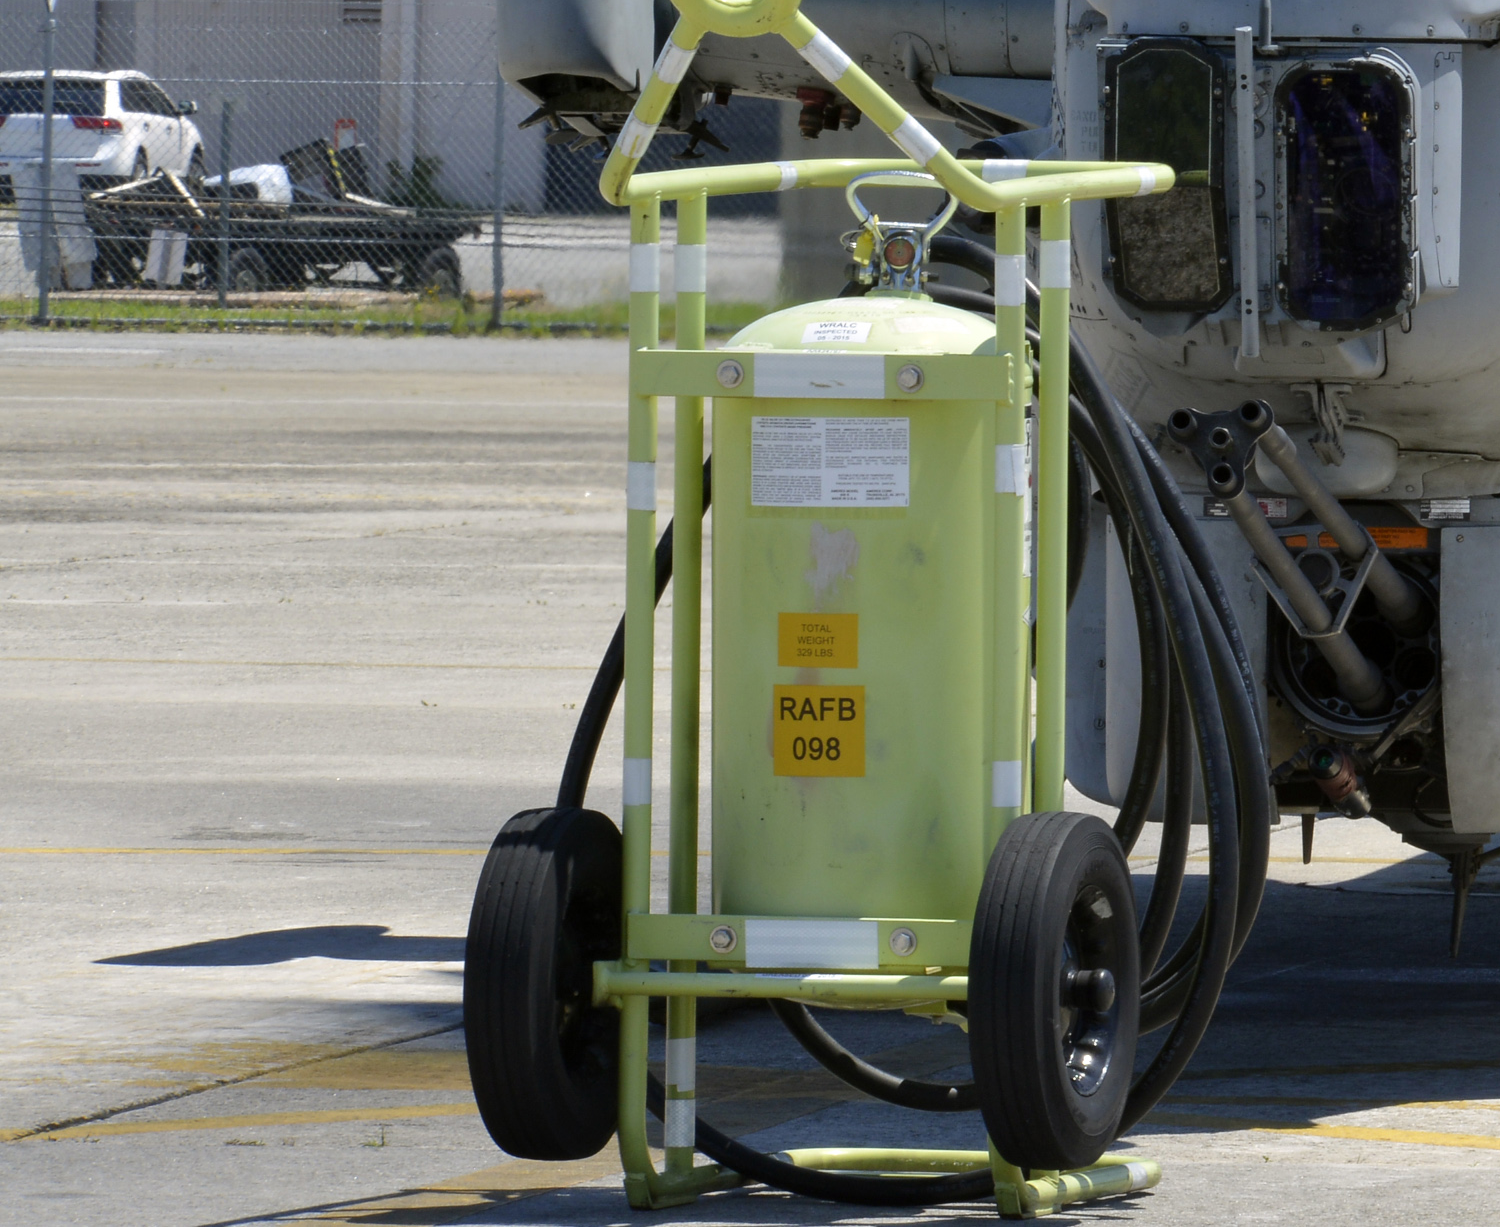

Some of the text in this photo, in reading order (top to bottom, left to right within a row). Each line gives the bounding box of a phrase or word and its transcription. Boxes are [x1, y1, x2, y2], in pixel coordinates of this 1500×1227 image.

[801, 623, 832, 633] TOTAL
[797, 636, 835, 645] WEIGHT
[796, 648, 812, 657] 329
[780, 696, 857, 722] RAFB
[792, 736, 841, 761] 098
